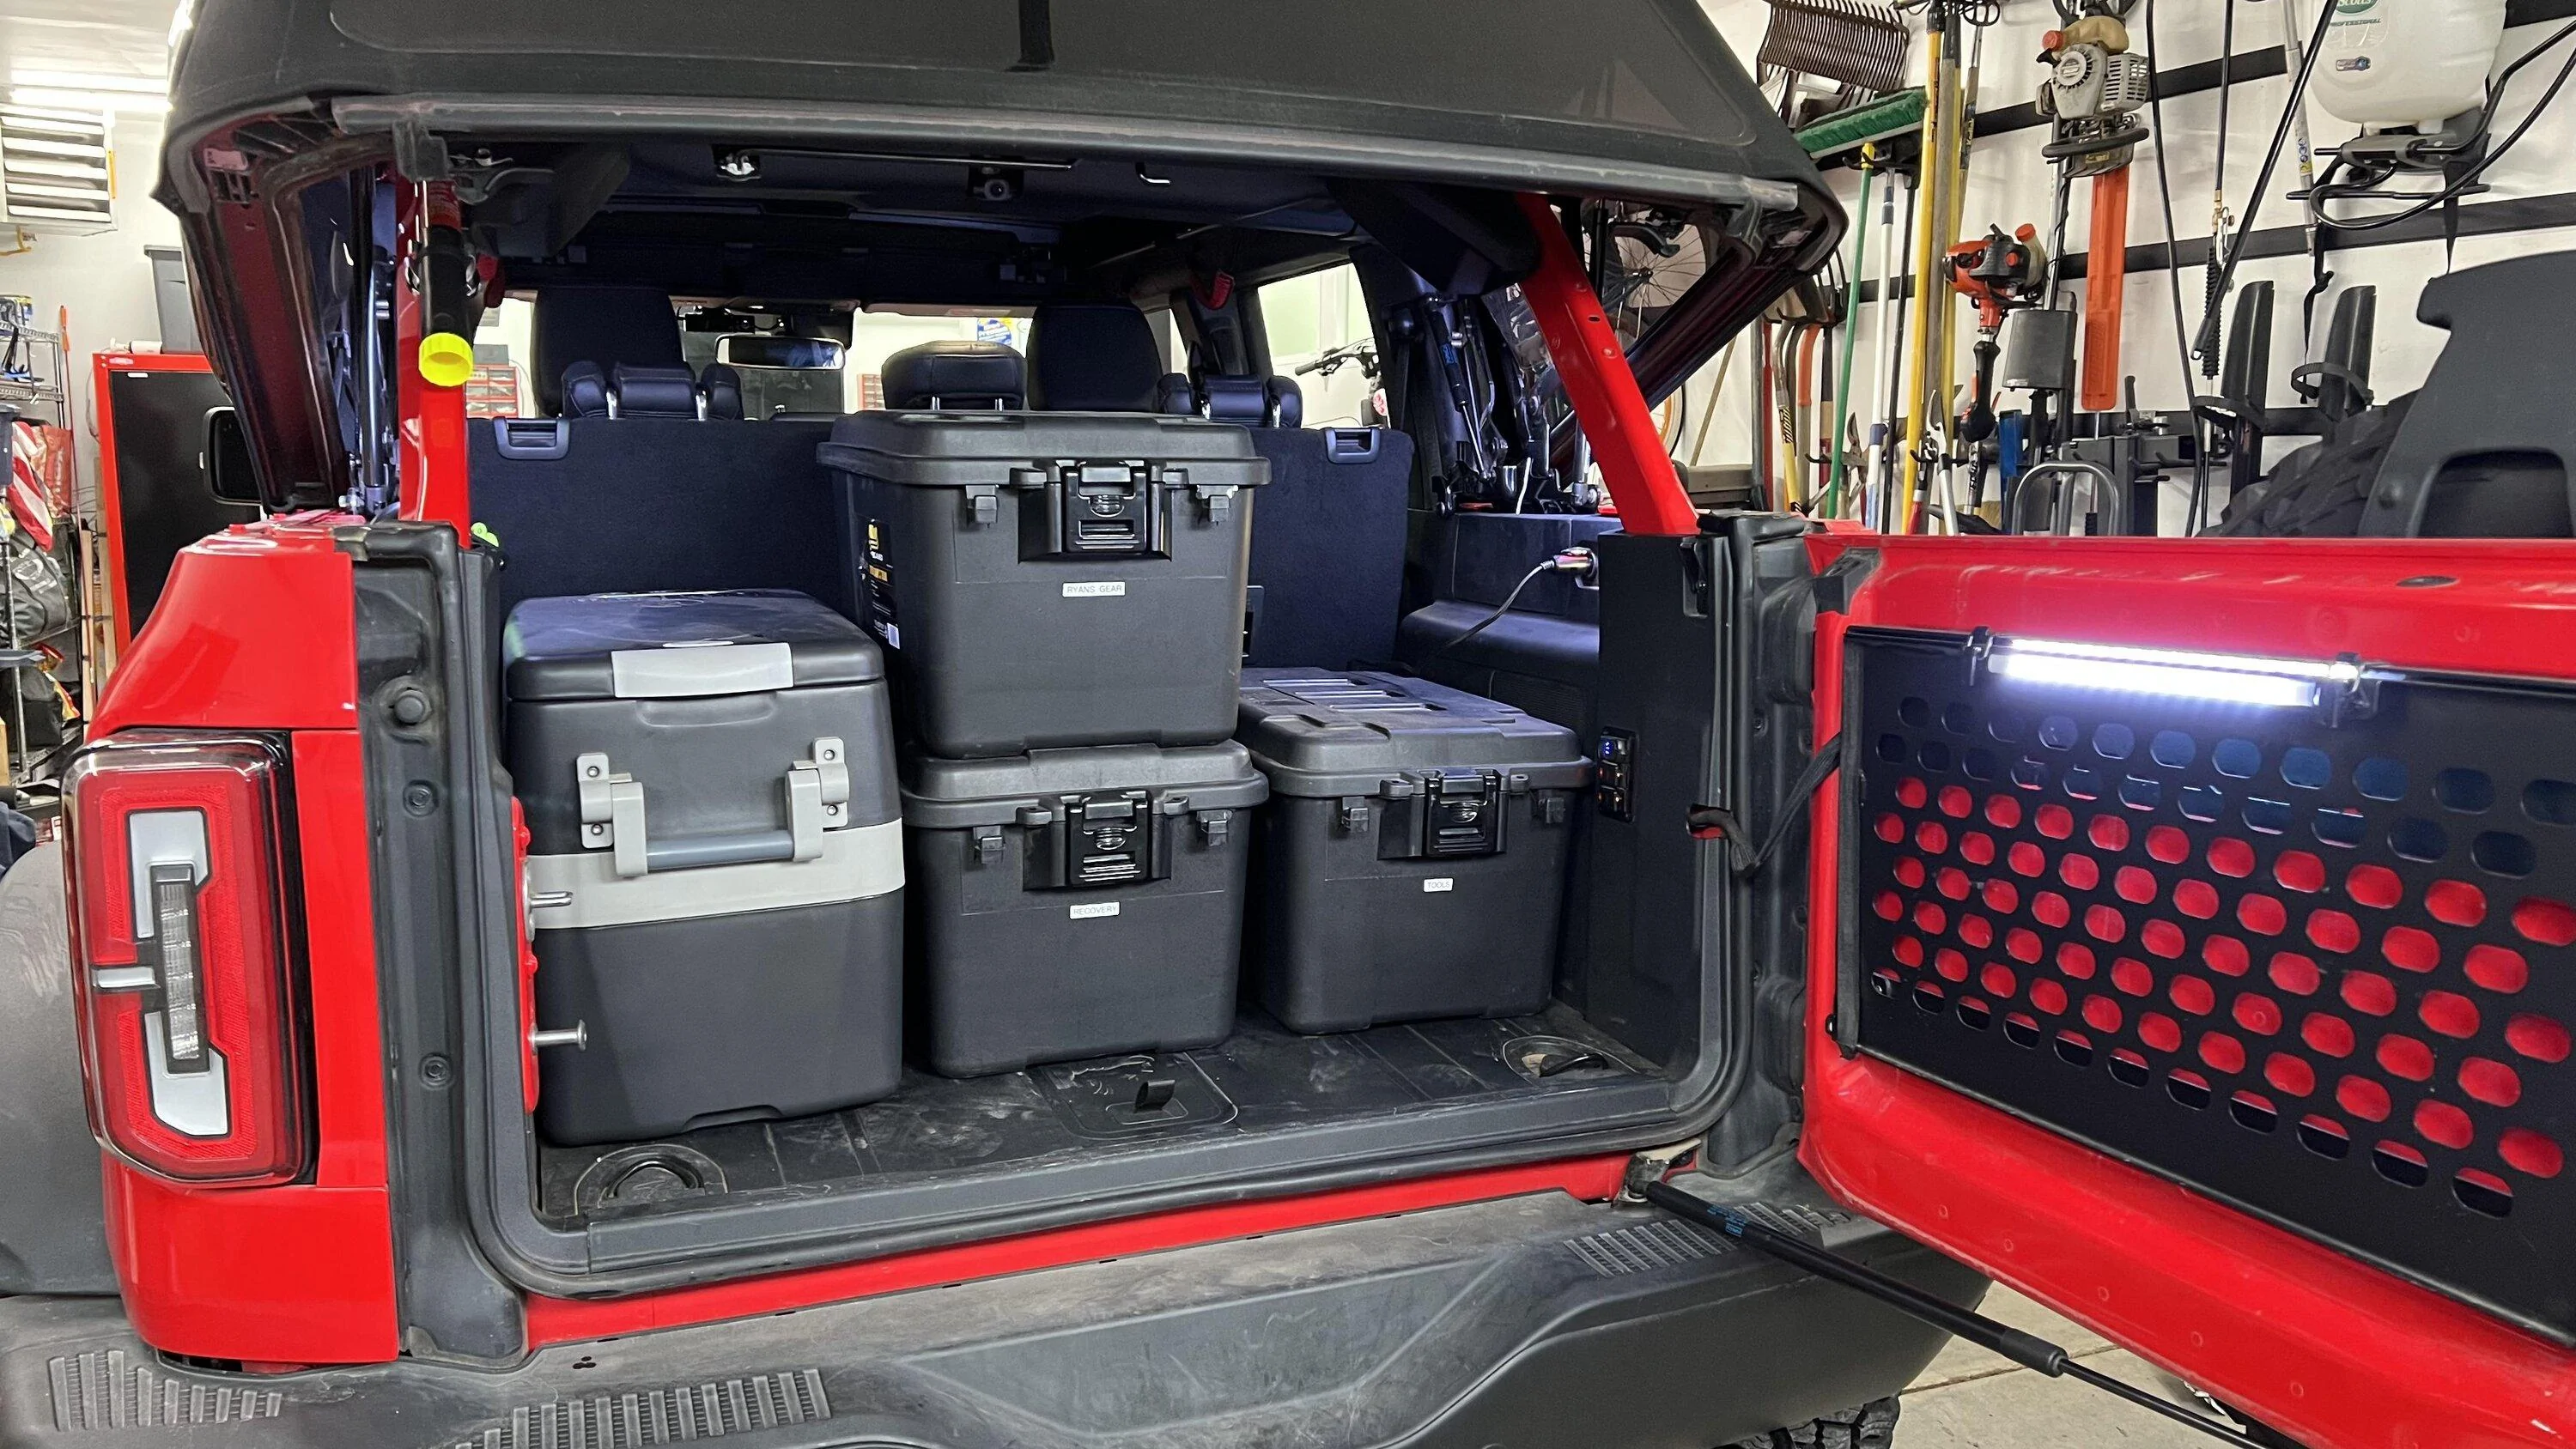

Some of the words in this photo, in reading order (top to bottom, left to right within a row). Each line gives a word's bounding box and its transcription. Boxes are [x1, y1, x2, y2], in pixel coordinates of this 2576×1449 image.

[1099, 585, 1122, 593] GEAR
[1427, 881, 1450, 889] TOOLS
[1073, 906, 1117, 916] RECOVERY
